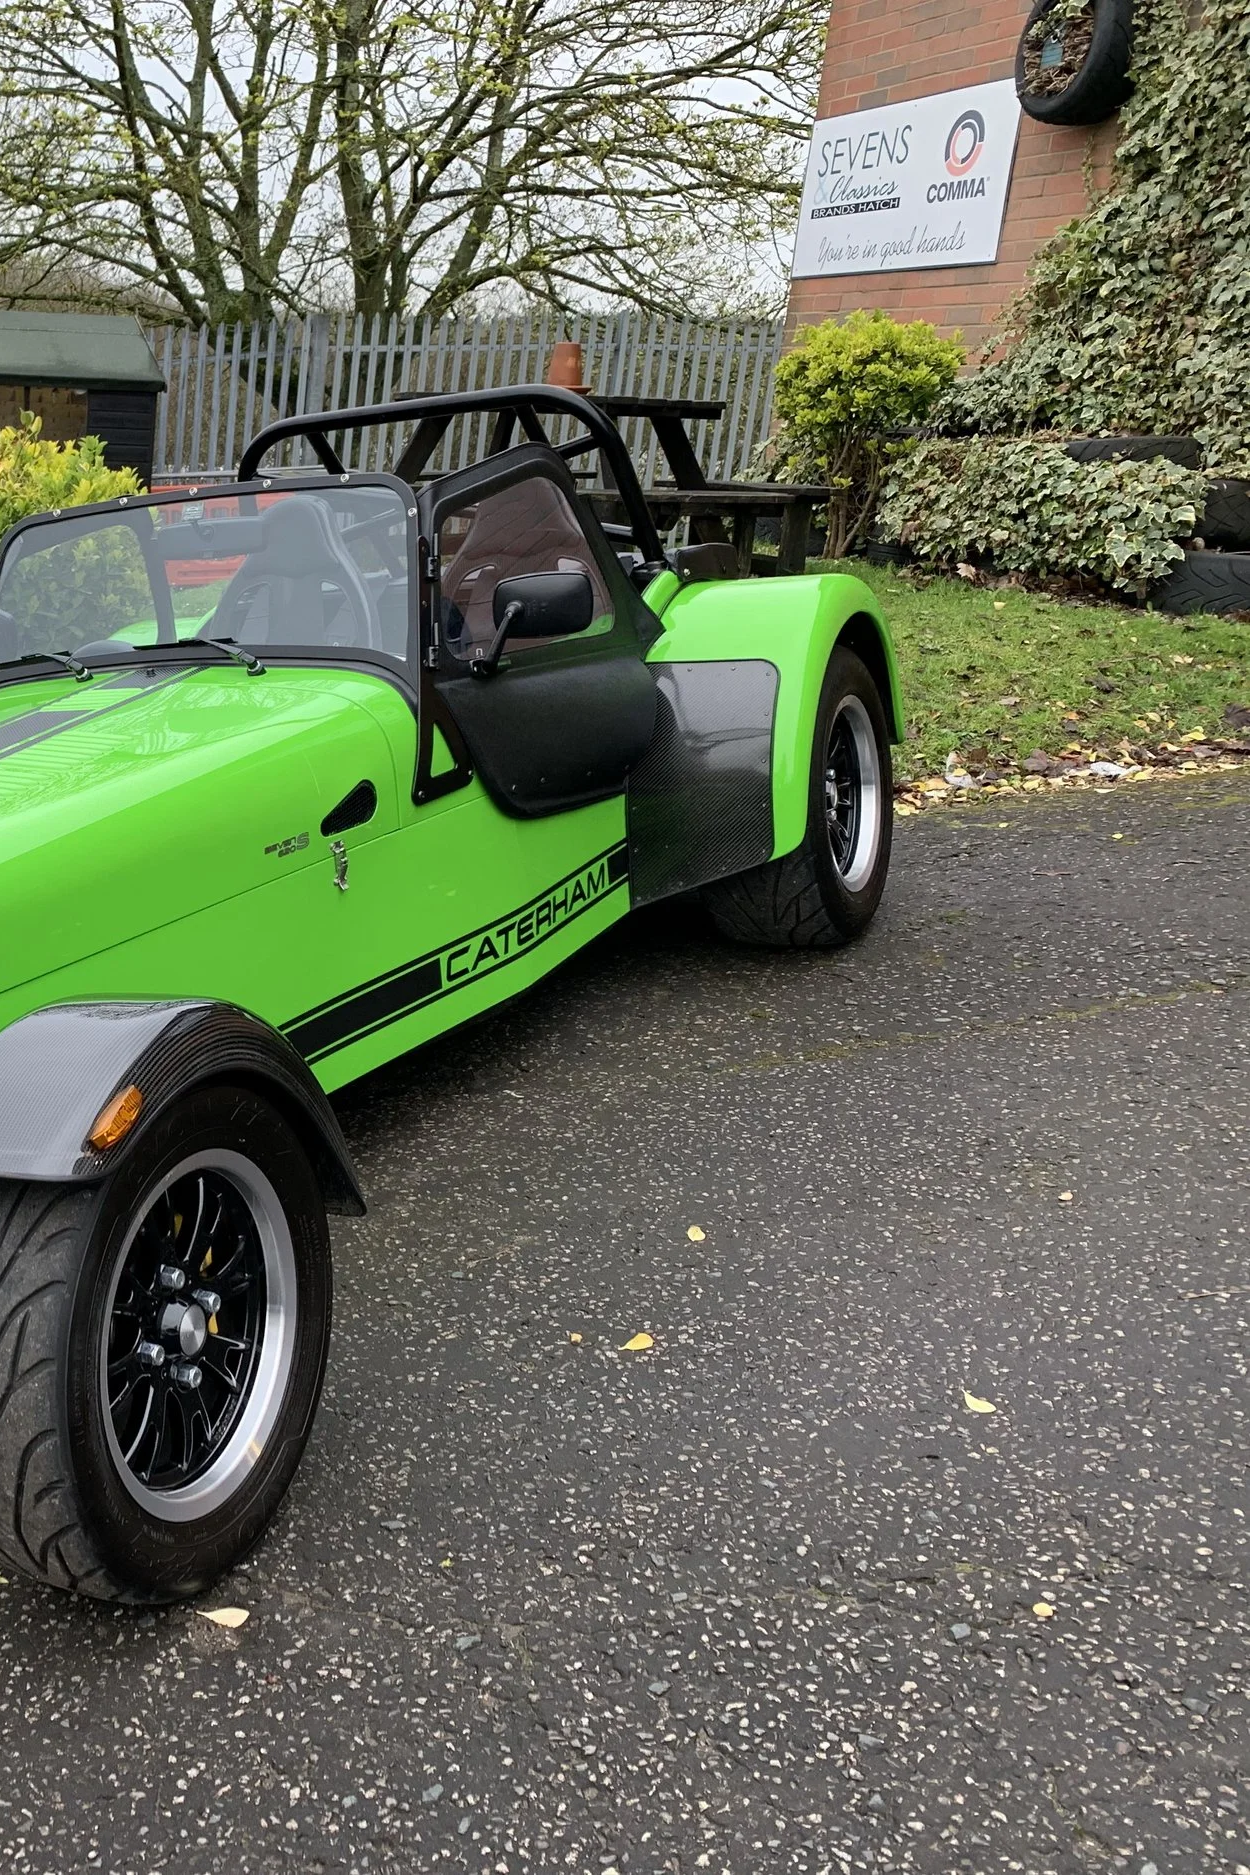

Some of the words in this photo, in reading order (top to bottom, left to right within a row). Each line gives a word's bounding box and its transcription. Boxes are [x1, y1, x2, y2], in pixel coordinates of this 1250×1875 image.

[818, 124, 912, 178] SEVENS
[812, 204, 856, 218] BRANDS
[858, 198, 898, 212] HATCH
[830, 175, 899, 204] Classics
[926, 177, 985, 204] COMMA
[817, 233, 859, 271] You're
[862, 239, 878, 259] in
[880, 225, 917, 267] good
[916, 220, 966, 253] hands
[446, 862, 605, 982] CATERHAM
